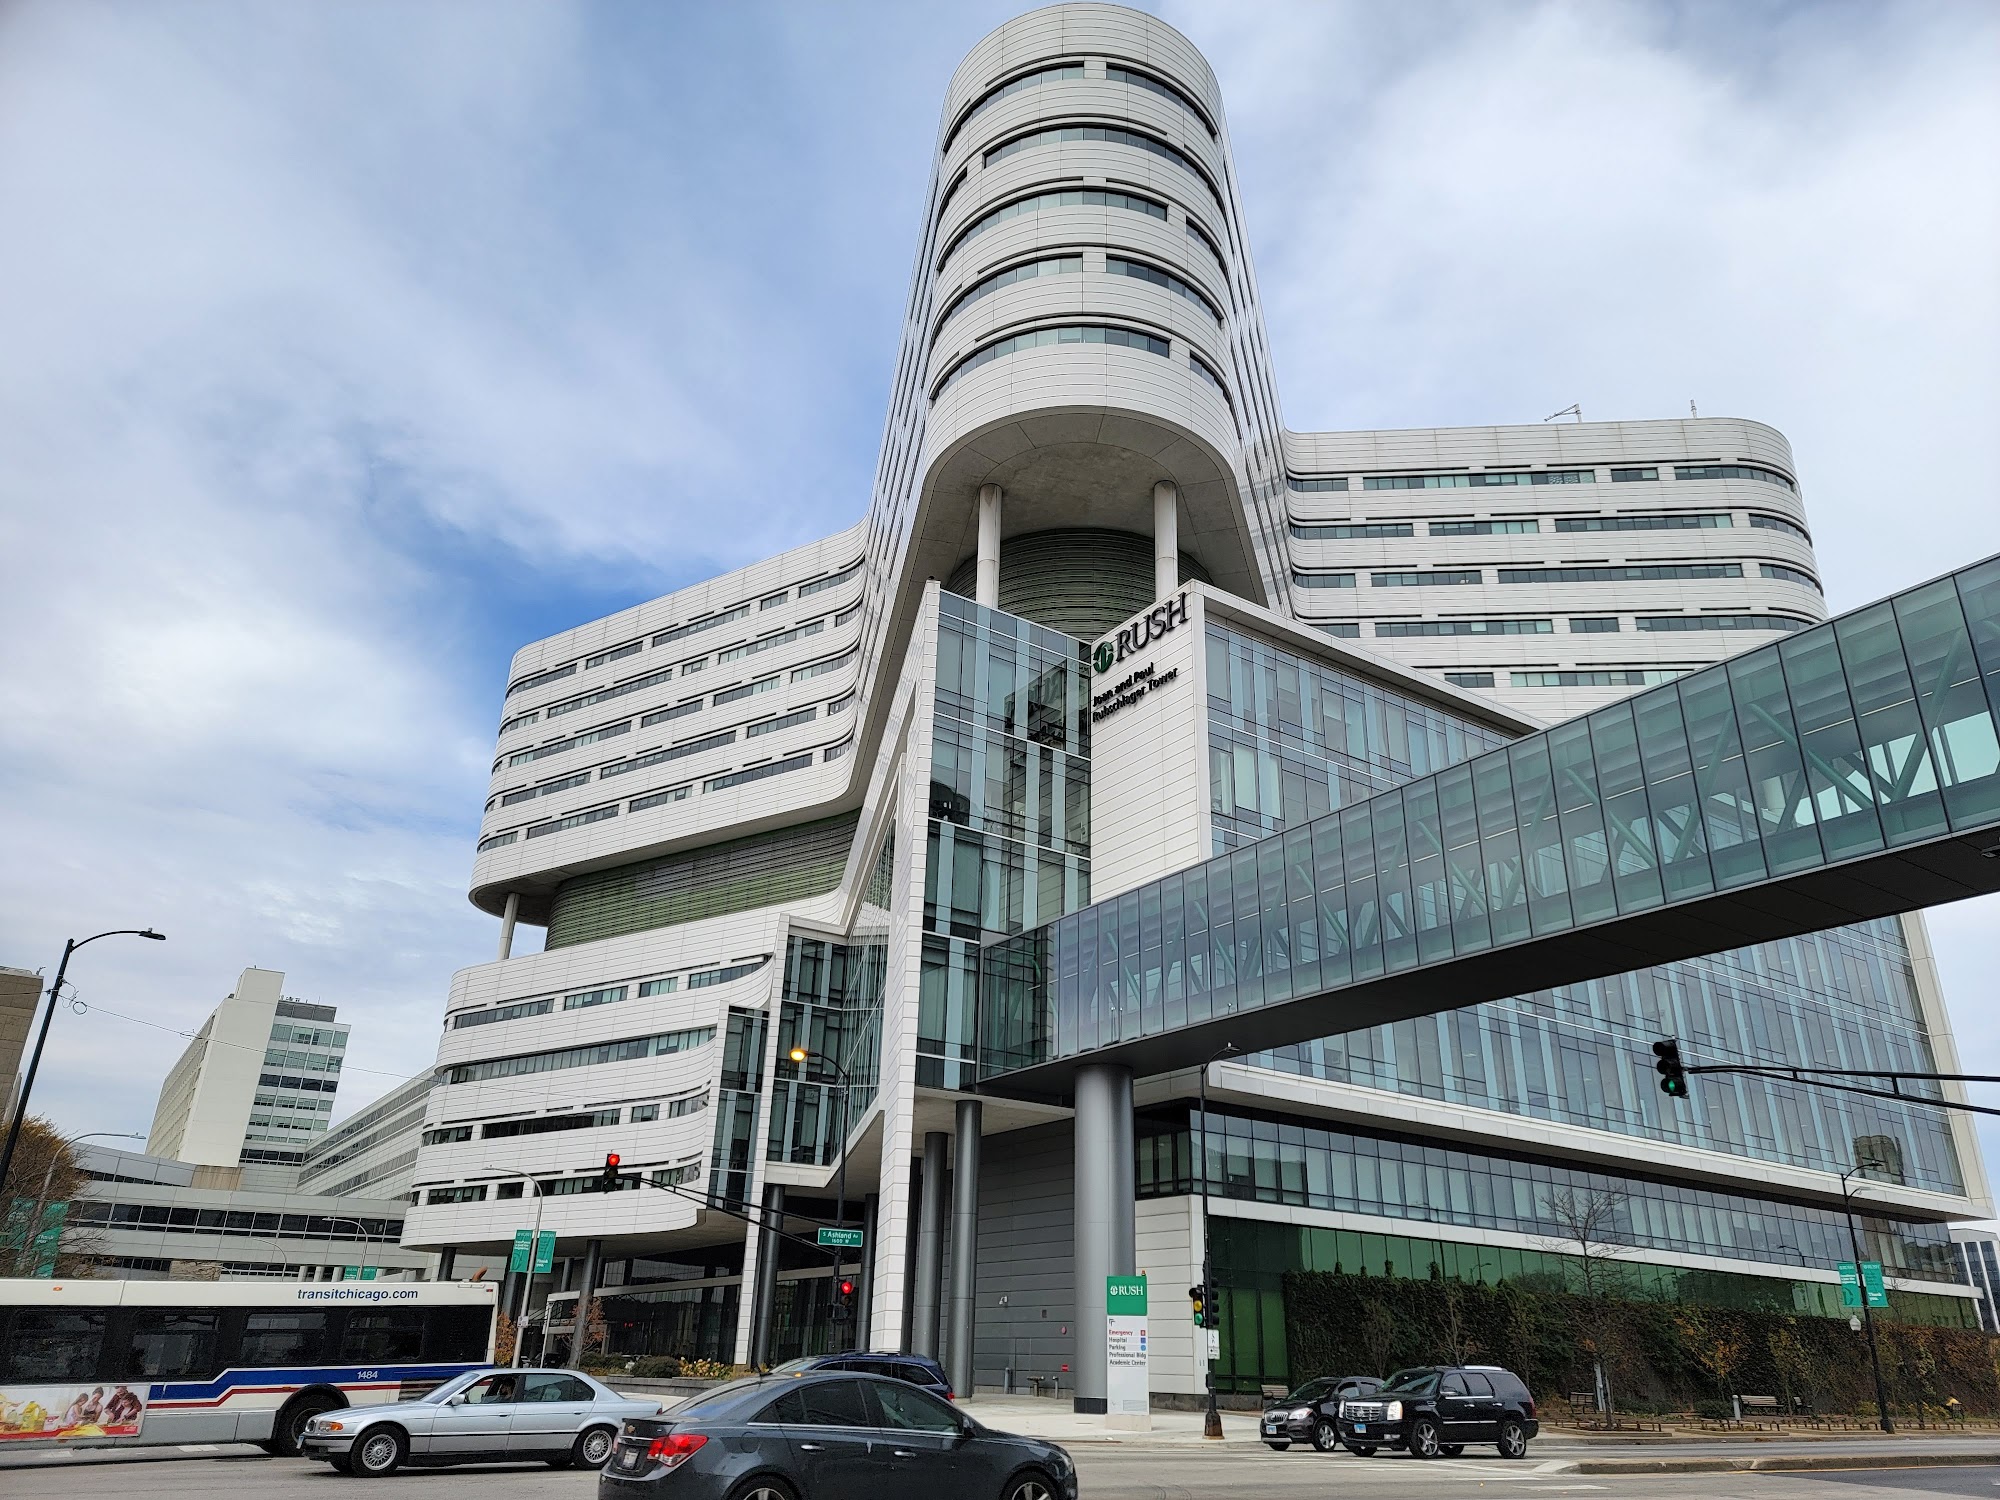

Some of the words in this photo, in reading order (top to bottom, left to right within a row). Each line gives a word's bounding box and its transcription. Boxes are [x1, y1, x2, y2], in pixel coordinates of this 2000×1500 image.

[1115, 592, 1189, 662] RUSH
[1093, 688, 1114, 707] Joan
[1114, 675, 1133, 694] and
[1133, 662, 1155, 683] Paul
[1092, 687, 1146, 723] Rubschlager
[1146, 668, 1179, 691] Tower
[297, 1287, 419, 1302] transitchicago.com
[1118, 1285, 1144, 1296] RUSH
[1136, 1351, 1146, 1359] Bldg
[357, 1370, 379, 1380] 1484
